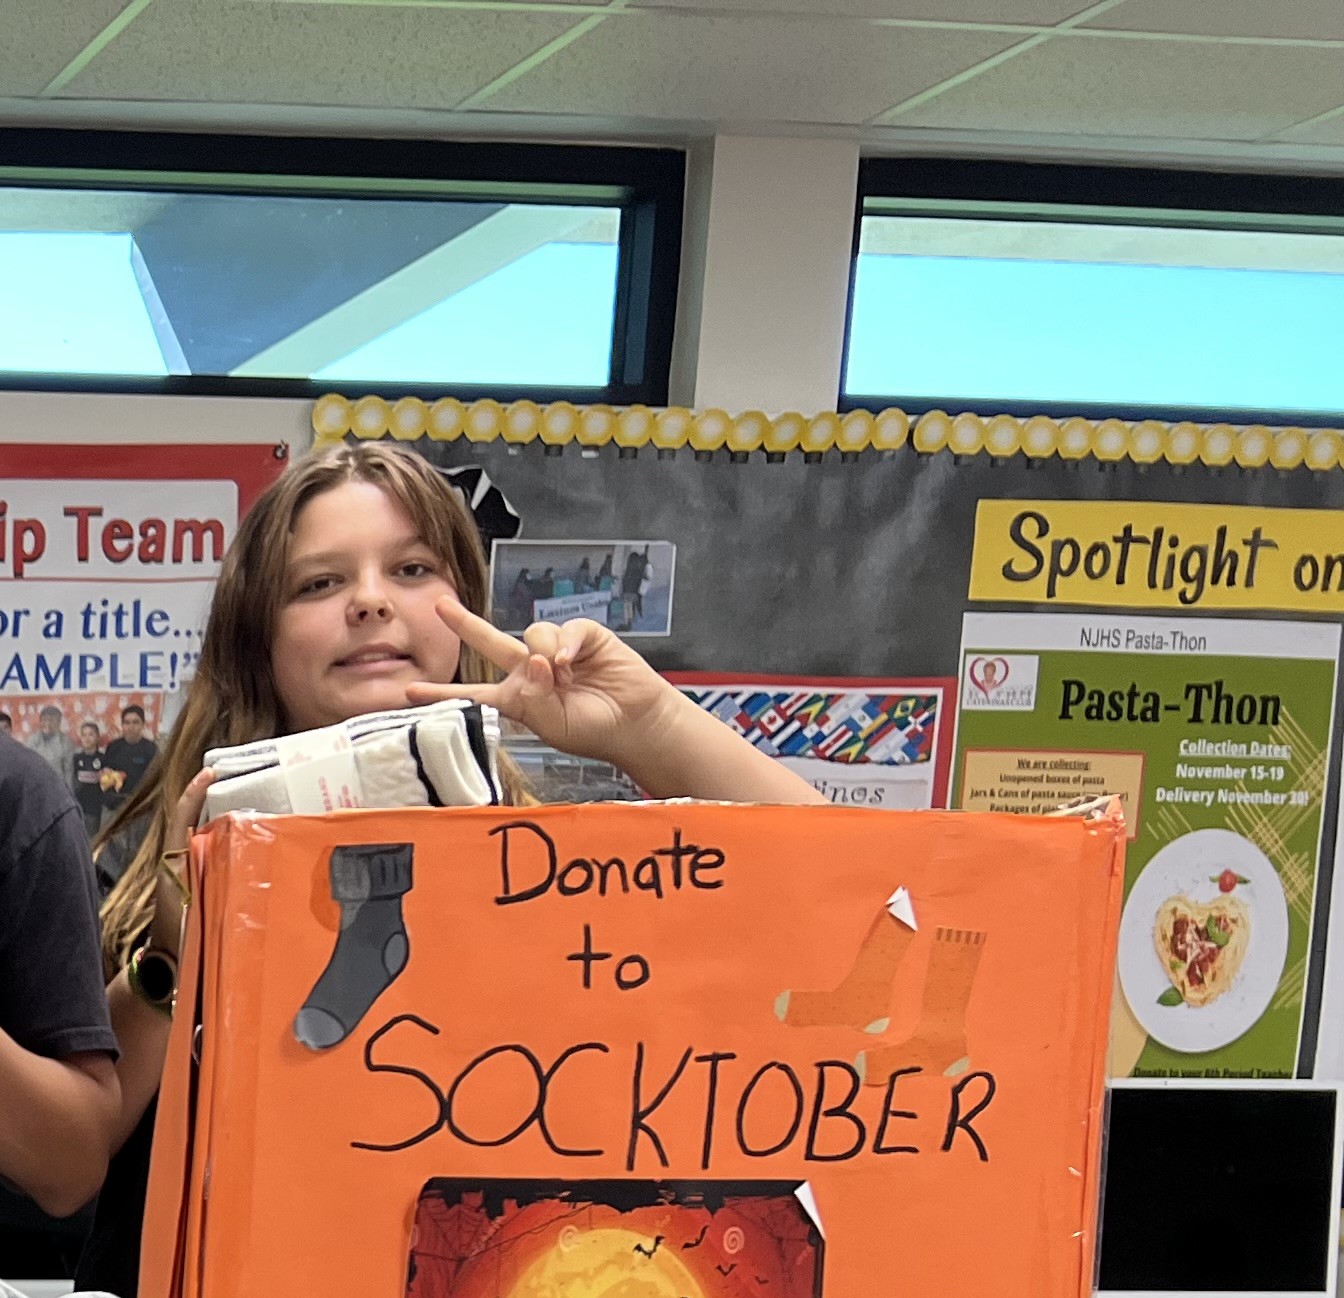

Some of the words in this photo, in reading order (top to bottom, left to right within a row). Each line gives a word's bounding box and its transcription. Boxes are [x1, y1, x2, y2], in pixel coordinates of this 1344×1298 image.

[63, 505, 225, 562] Team
[1001, 510, 1280, 605] Spotlight
[41, 607, 64, 638] a
[1080, 627, 1121, 649] NJHS
[1125, 629, 1207, 652] Pasta-Thon
[1057, 678, 1282, 728] Pasta-Thon
[1179, 738, 1247, 758] Collection
[1017, 758, 1032, 770] We
[1033, 760, 1047, 770] are
[1176, 763, 1247, 780] November
[1250, 765, 1285, 781] 15-19
[999, 773, 1044, 785] Unopened
[1046, 774, 1071, 784] boxes
[1072, 774, 1081, 784] of
[1082, 776, 1105, 786] pasta
[1020, 788, 1030, 798] of
[1031, 790, 1056, 800] pasta
[1156, 787, 1215, 808] Delivery
[1217, 788, 1288, 805] November
[489, 821, 725, 906] Donate
[565, 922, 650, 992] to
[350, 1012, 997, 1172] SOCKTOBER
